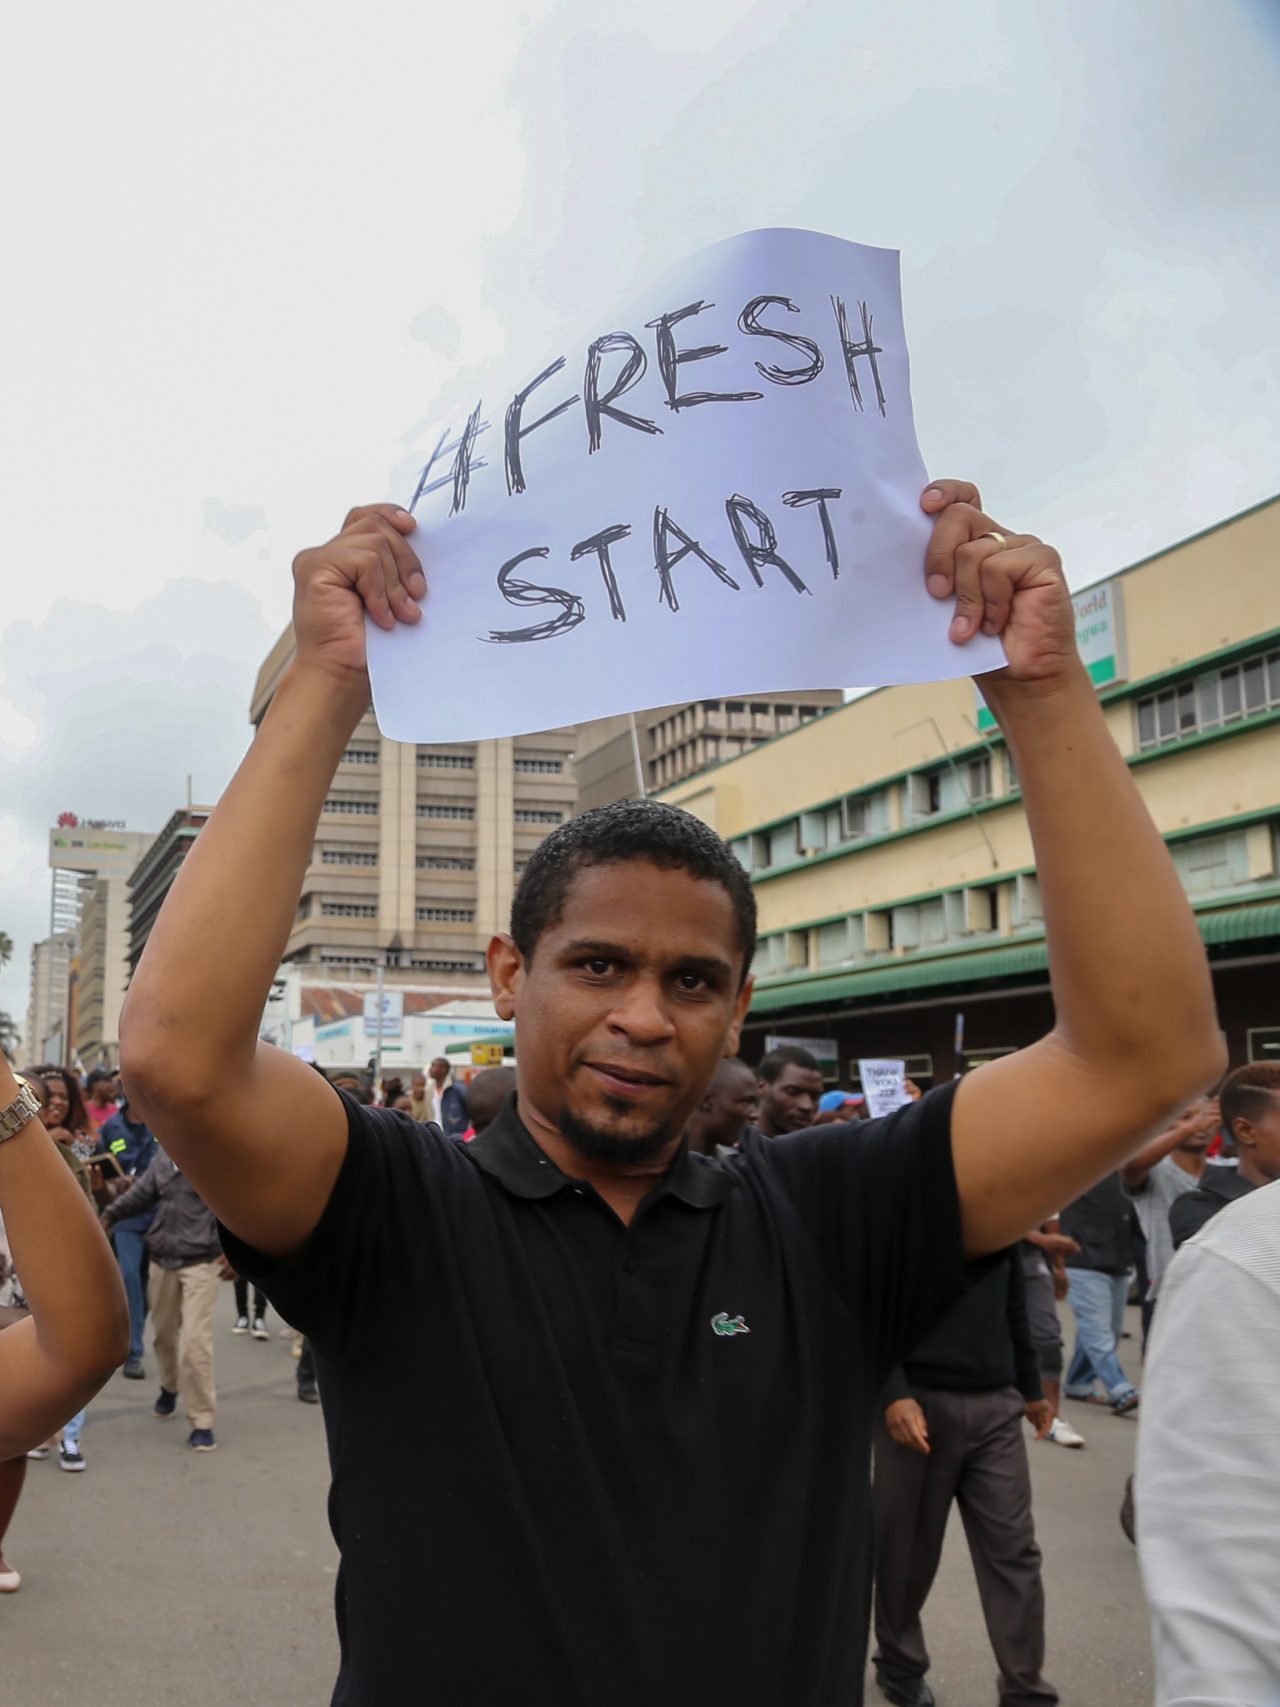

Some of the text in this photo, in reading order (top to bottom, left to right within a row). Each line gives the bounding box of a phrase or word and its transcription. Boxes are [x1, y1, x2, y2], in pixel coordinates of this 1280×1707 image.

[408, 294, 886, 518] #FRESH
[477, 488, 842, 643] START
[1074, 588, 1108, 618] orld
